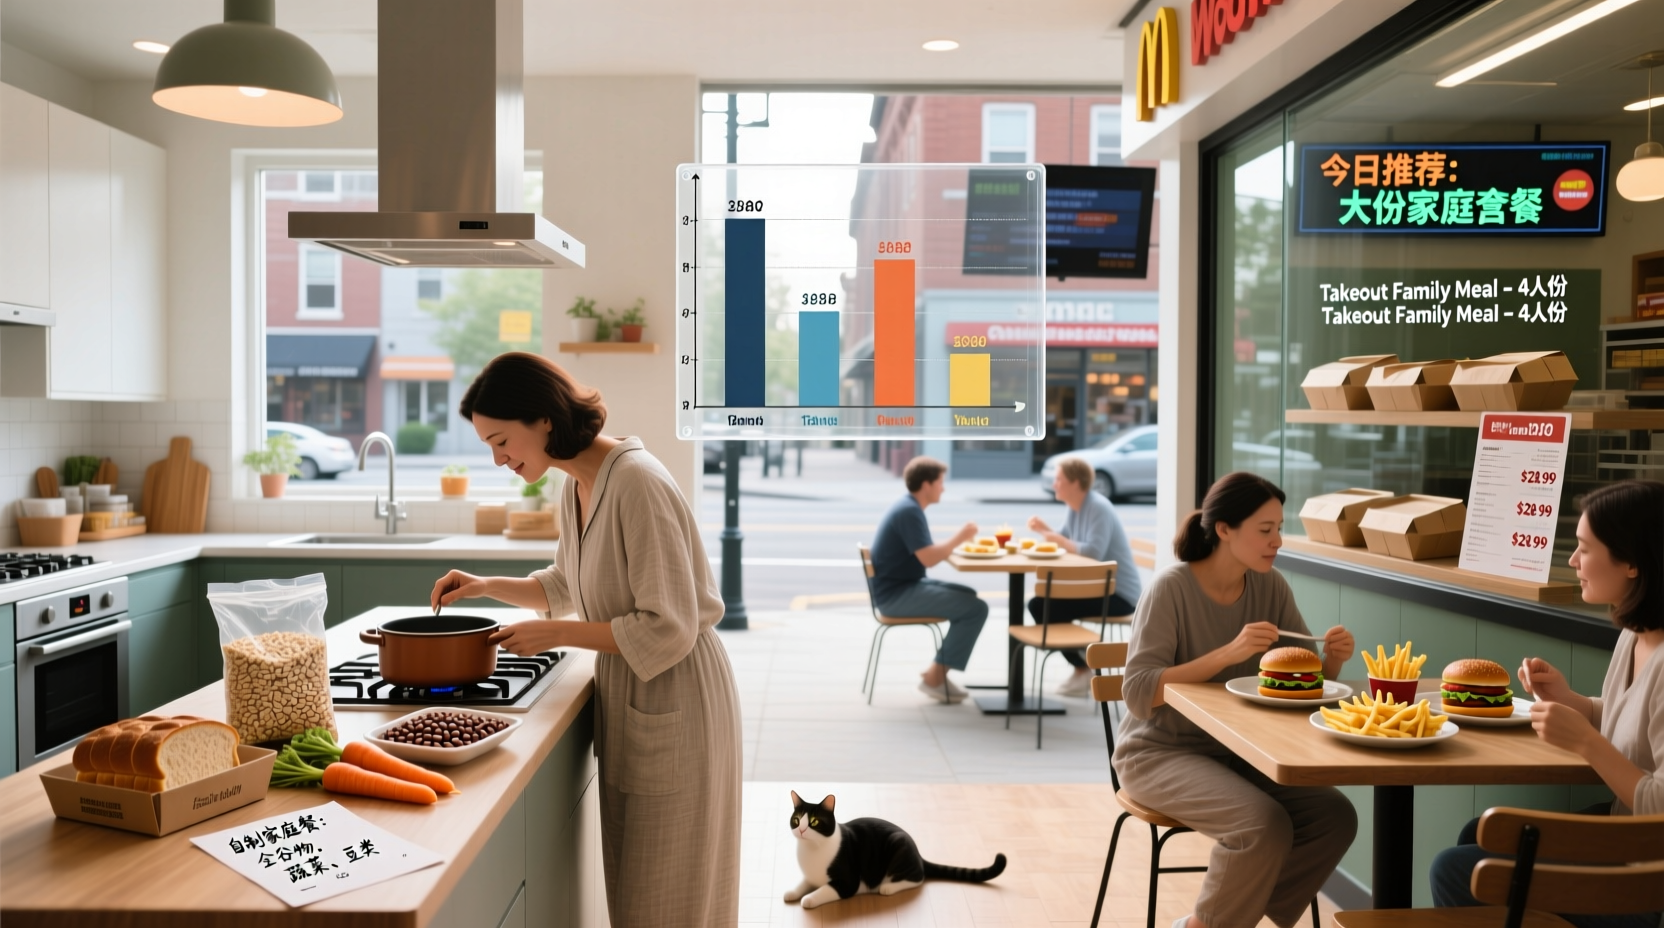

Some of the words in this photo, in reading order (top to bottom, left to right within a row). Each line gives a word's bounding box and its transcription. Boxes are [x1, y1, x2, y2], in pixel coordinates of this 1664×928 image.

[1319, 283, 1389, 302] Takeout
[1392, 280, 1451, 304] Family
[1454, 278, 1498, 298] Meal
[1517, 273, 1568, 298] 4人份
[1321, 305, 1391, 325] Takeout
[1395, 304, 1452, 328] Family
[1456, 303, 1499, 323] Meal
[1517, 300, 1568, 324] 4人份
